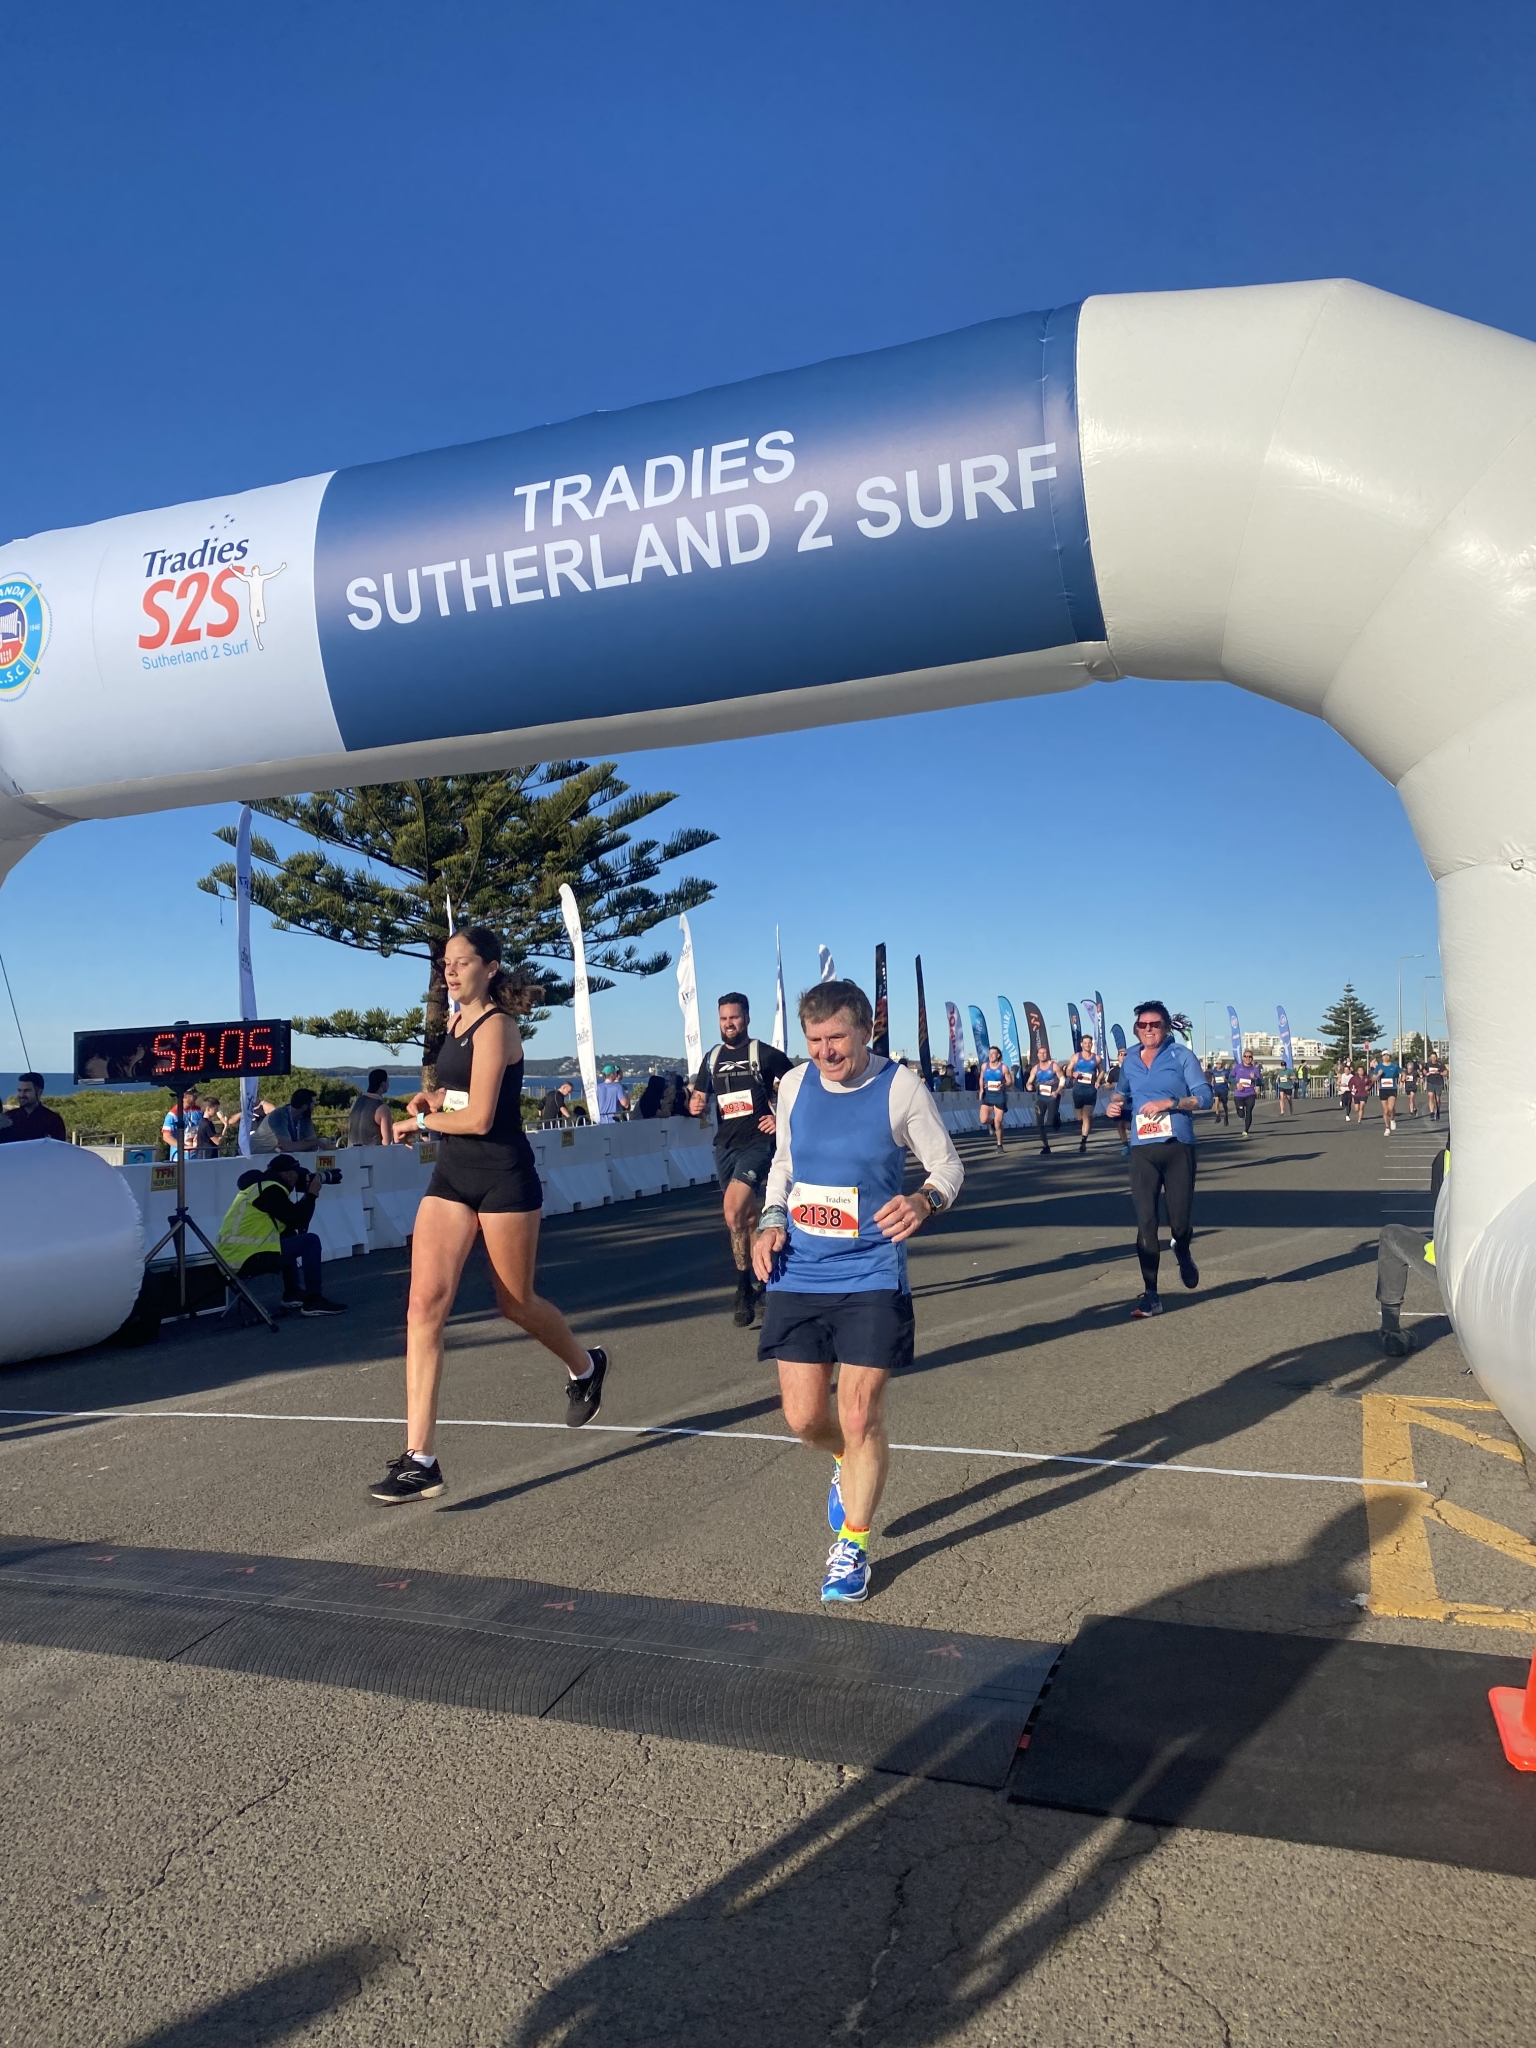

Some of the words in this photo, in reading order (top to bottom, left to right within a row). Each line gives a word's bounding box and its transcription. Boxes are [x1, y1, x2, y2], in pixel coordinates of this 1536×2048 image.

[513, 430, 796, 532] TRADIES
[346, 504, 771, 631] SUTHERLAND
[794, 490, 833, 552] 2
[856, 443, 1058, 538] SURF
[142, 538, 249, 577] Tradies
[138, 565, 245, 650] S2S
[142, 649, 209, 670] Sutherland
[212, 645, 220, 658] 2
[223, 639, 249, 657] Surf
[153, 1027, 273, 1073] 58:05
[449, 1097, 464, 1105] Tradies
[724, 1101, 746, 1113] 2933
[155, 1168, 175, 1179] TFH
[318, 1157, 332, 1167] TFH
[825, 1195, 851, 1204] Tradies
[800, 1204, 842, 1227] 2138
